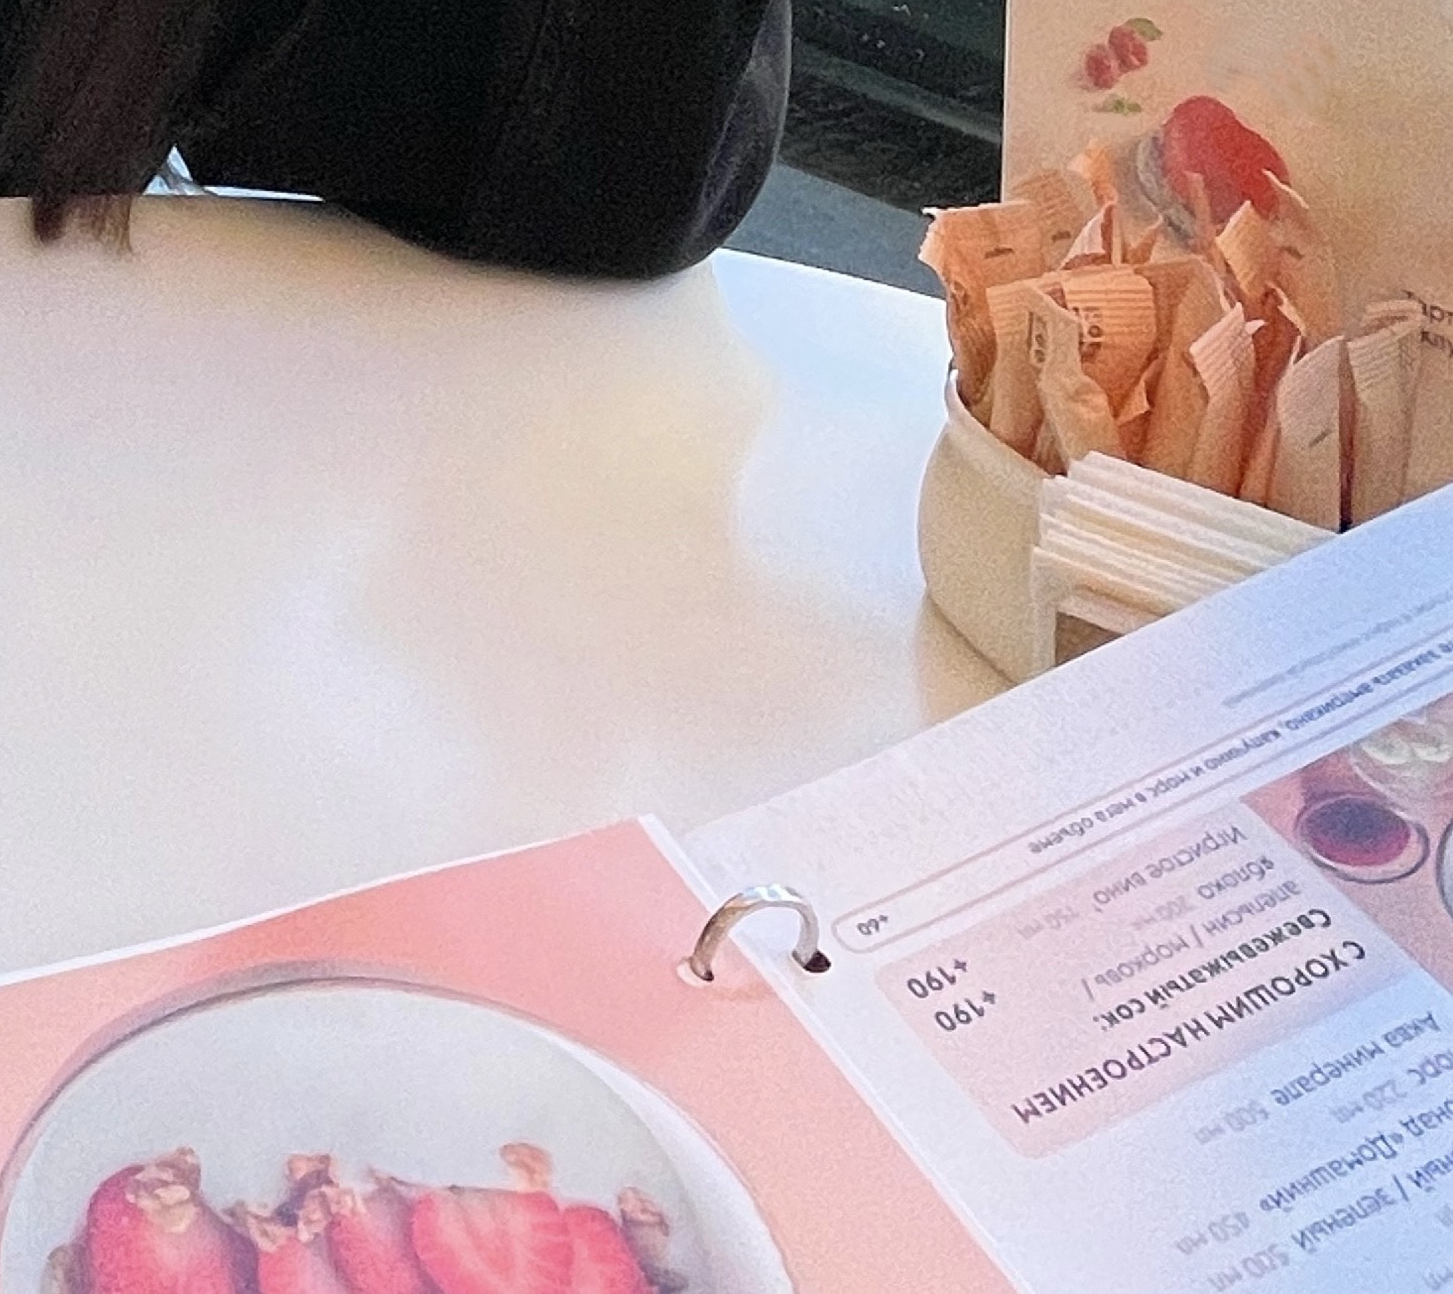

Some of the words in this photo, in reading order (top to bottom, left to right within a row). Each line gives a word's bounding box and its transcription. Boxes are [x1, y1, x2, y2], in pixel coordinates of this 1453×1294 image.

[1143, 823, 1250, 880] Игристое
[1196, 856, 1276, 901] яблоко
[855, 914, 889, 937] +60
[1201, 880, 1301, 937] апельсин
[1093, 933, 1191, 986] морковь
[1142, 908, 1333, 1011] Свежевыжатый
[1342, 940, 1366, 961] С
[905, 958, 968, 1000] +190
[1203, 948, 1348, 1031] ХОРОШИМ
[933, 990, 997, 1033] +190
[1091, 997, 1147, 1032] сок:
[1381, 1011, 1442, 1050] Аква
[1010, 1018, 1211, 1125] НАСТРОЕНИЕМ
[1269, 1041, 1386, 1107] минерале
[1259, 1131, 1404, 1213] «Домашний»
[1208, 1211, 1251, 1243] 450
[1290, 1187, 1396, 1255] зеленый
[1241, 1244, 1290, 1279] 500
